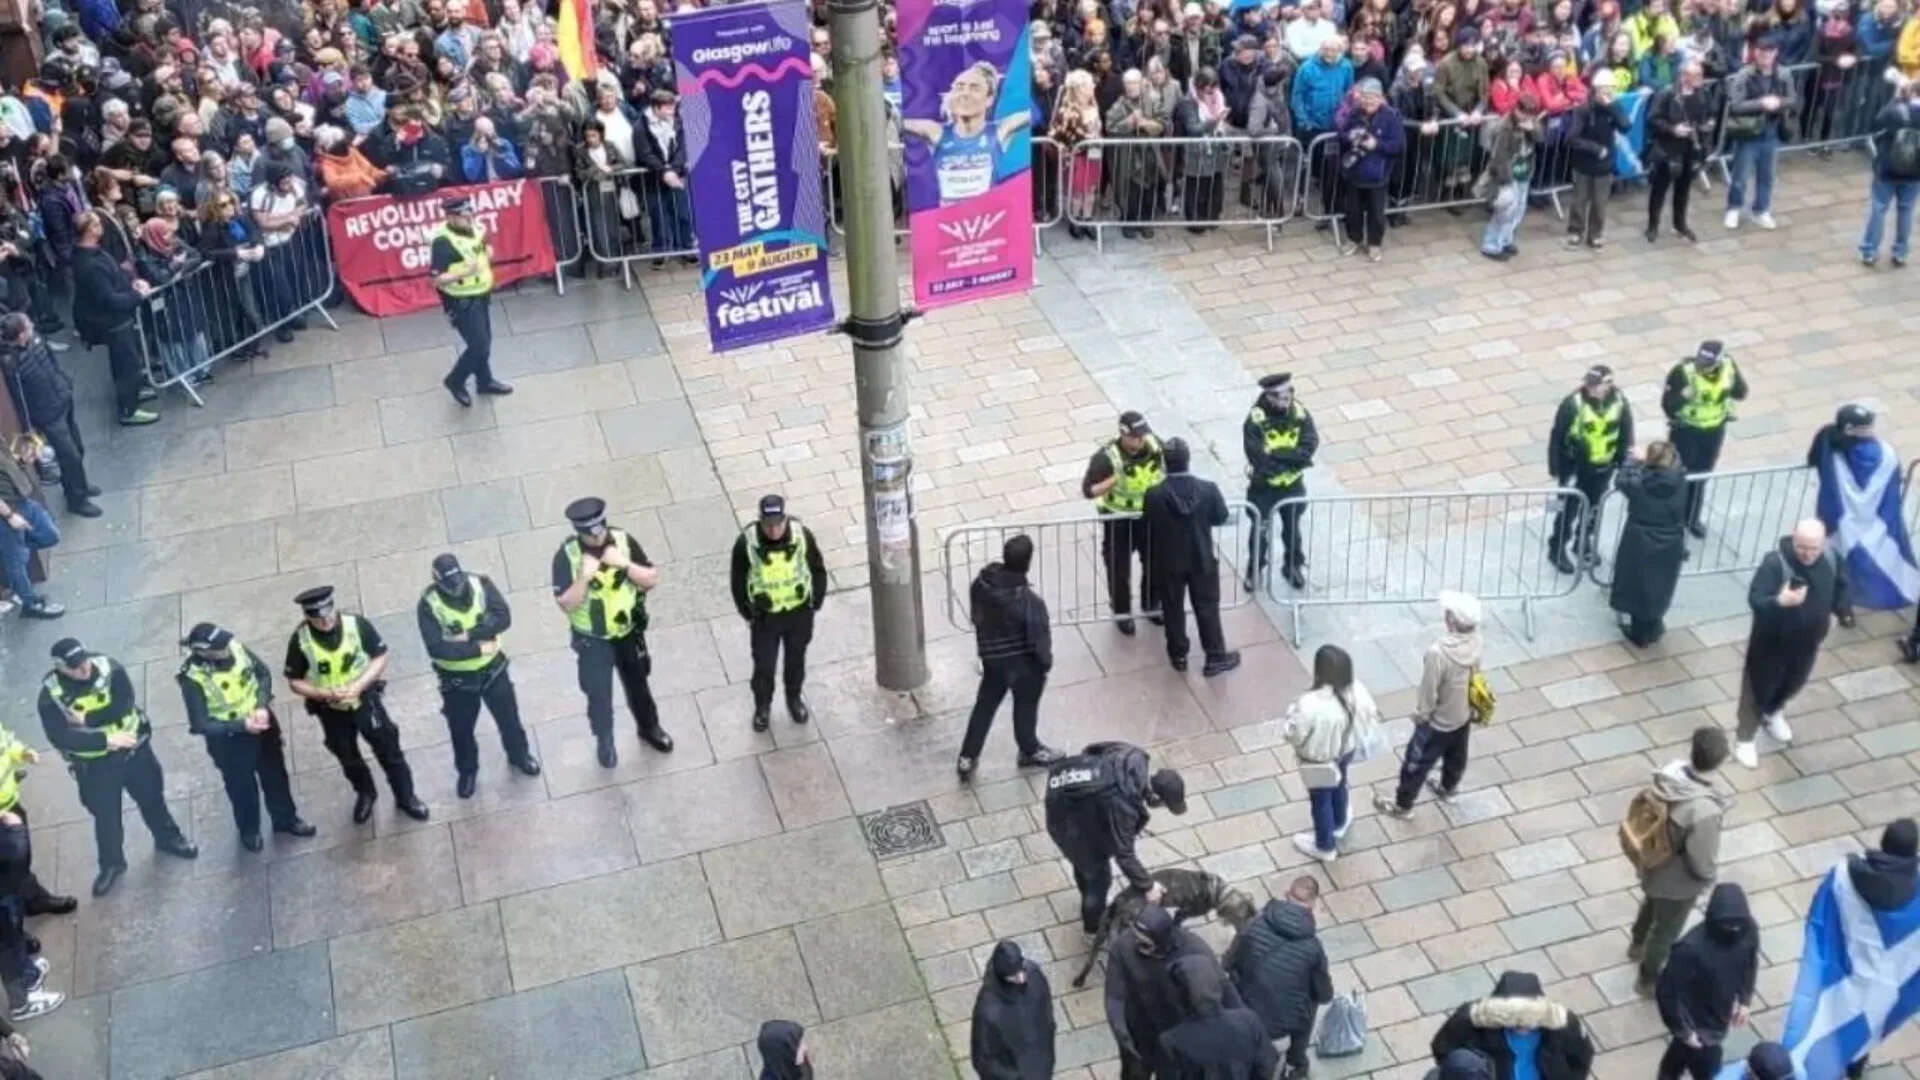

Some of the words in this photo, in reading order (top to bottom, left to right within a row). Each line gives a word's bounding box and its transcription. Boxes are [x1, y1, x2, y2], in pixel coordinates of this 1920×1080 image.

[731, 159, 751, 200] CITY
[741, 89, 781, 230] GATHERS
[345, 178, 526, 238] REVOLUTIARY
[736, 199, 755, 236] THE
[732, 243, 760, 260] MAY
[758, 246, 811, 267] AUGUST
[716, 281, 824, 328] festival
